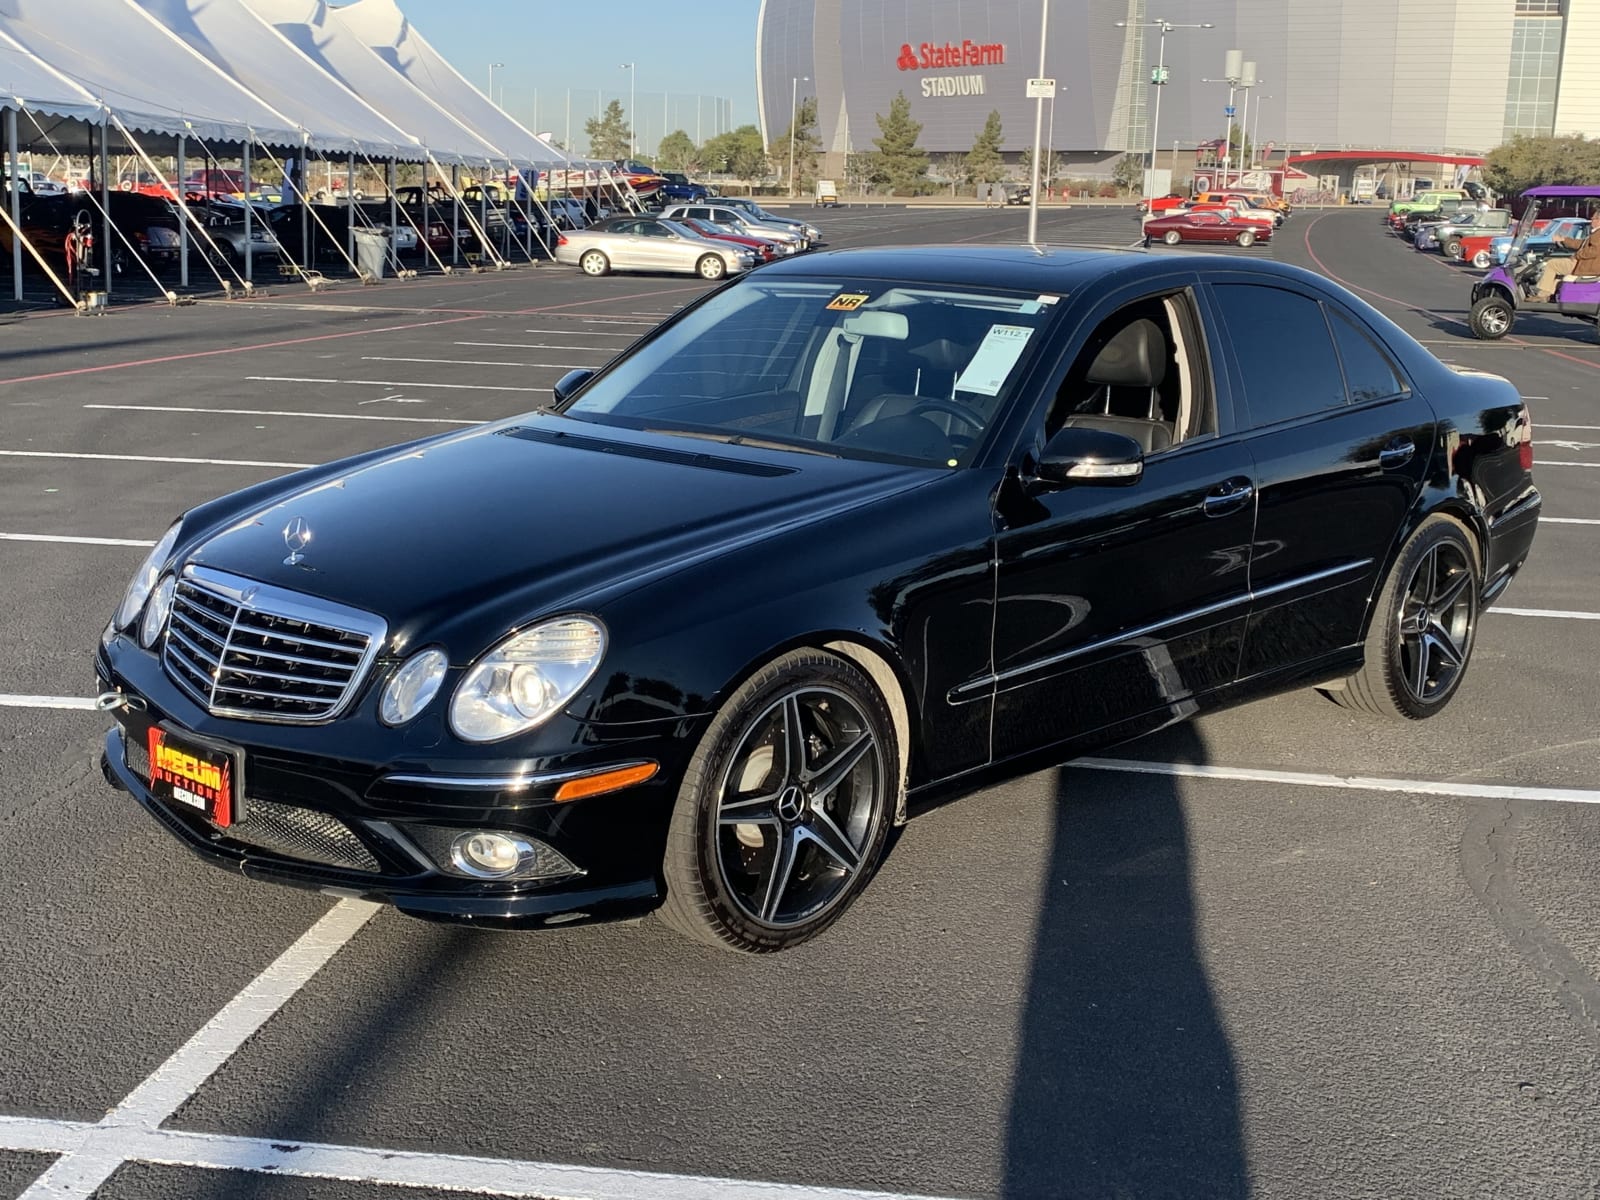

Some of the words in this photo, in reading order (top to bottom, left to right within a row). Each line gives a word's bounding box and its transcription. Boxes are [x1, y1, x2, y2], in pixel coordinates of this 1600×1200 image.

[921, 75, 984, 97] STADIUM
[832, 297, 861, 307] NR
[156, 744, 221, 791] MECUM
[156, 768, 221, 803] AUCTIONS
[173, 786, 206, 811] MECUM.COM
